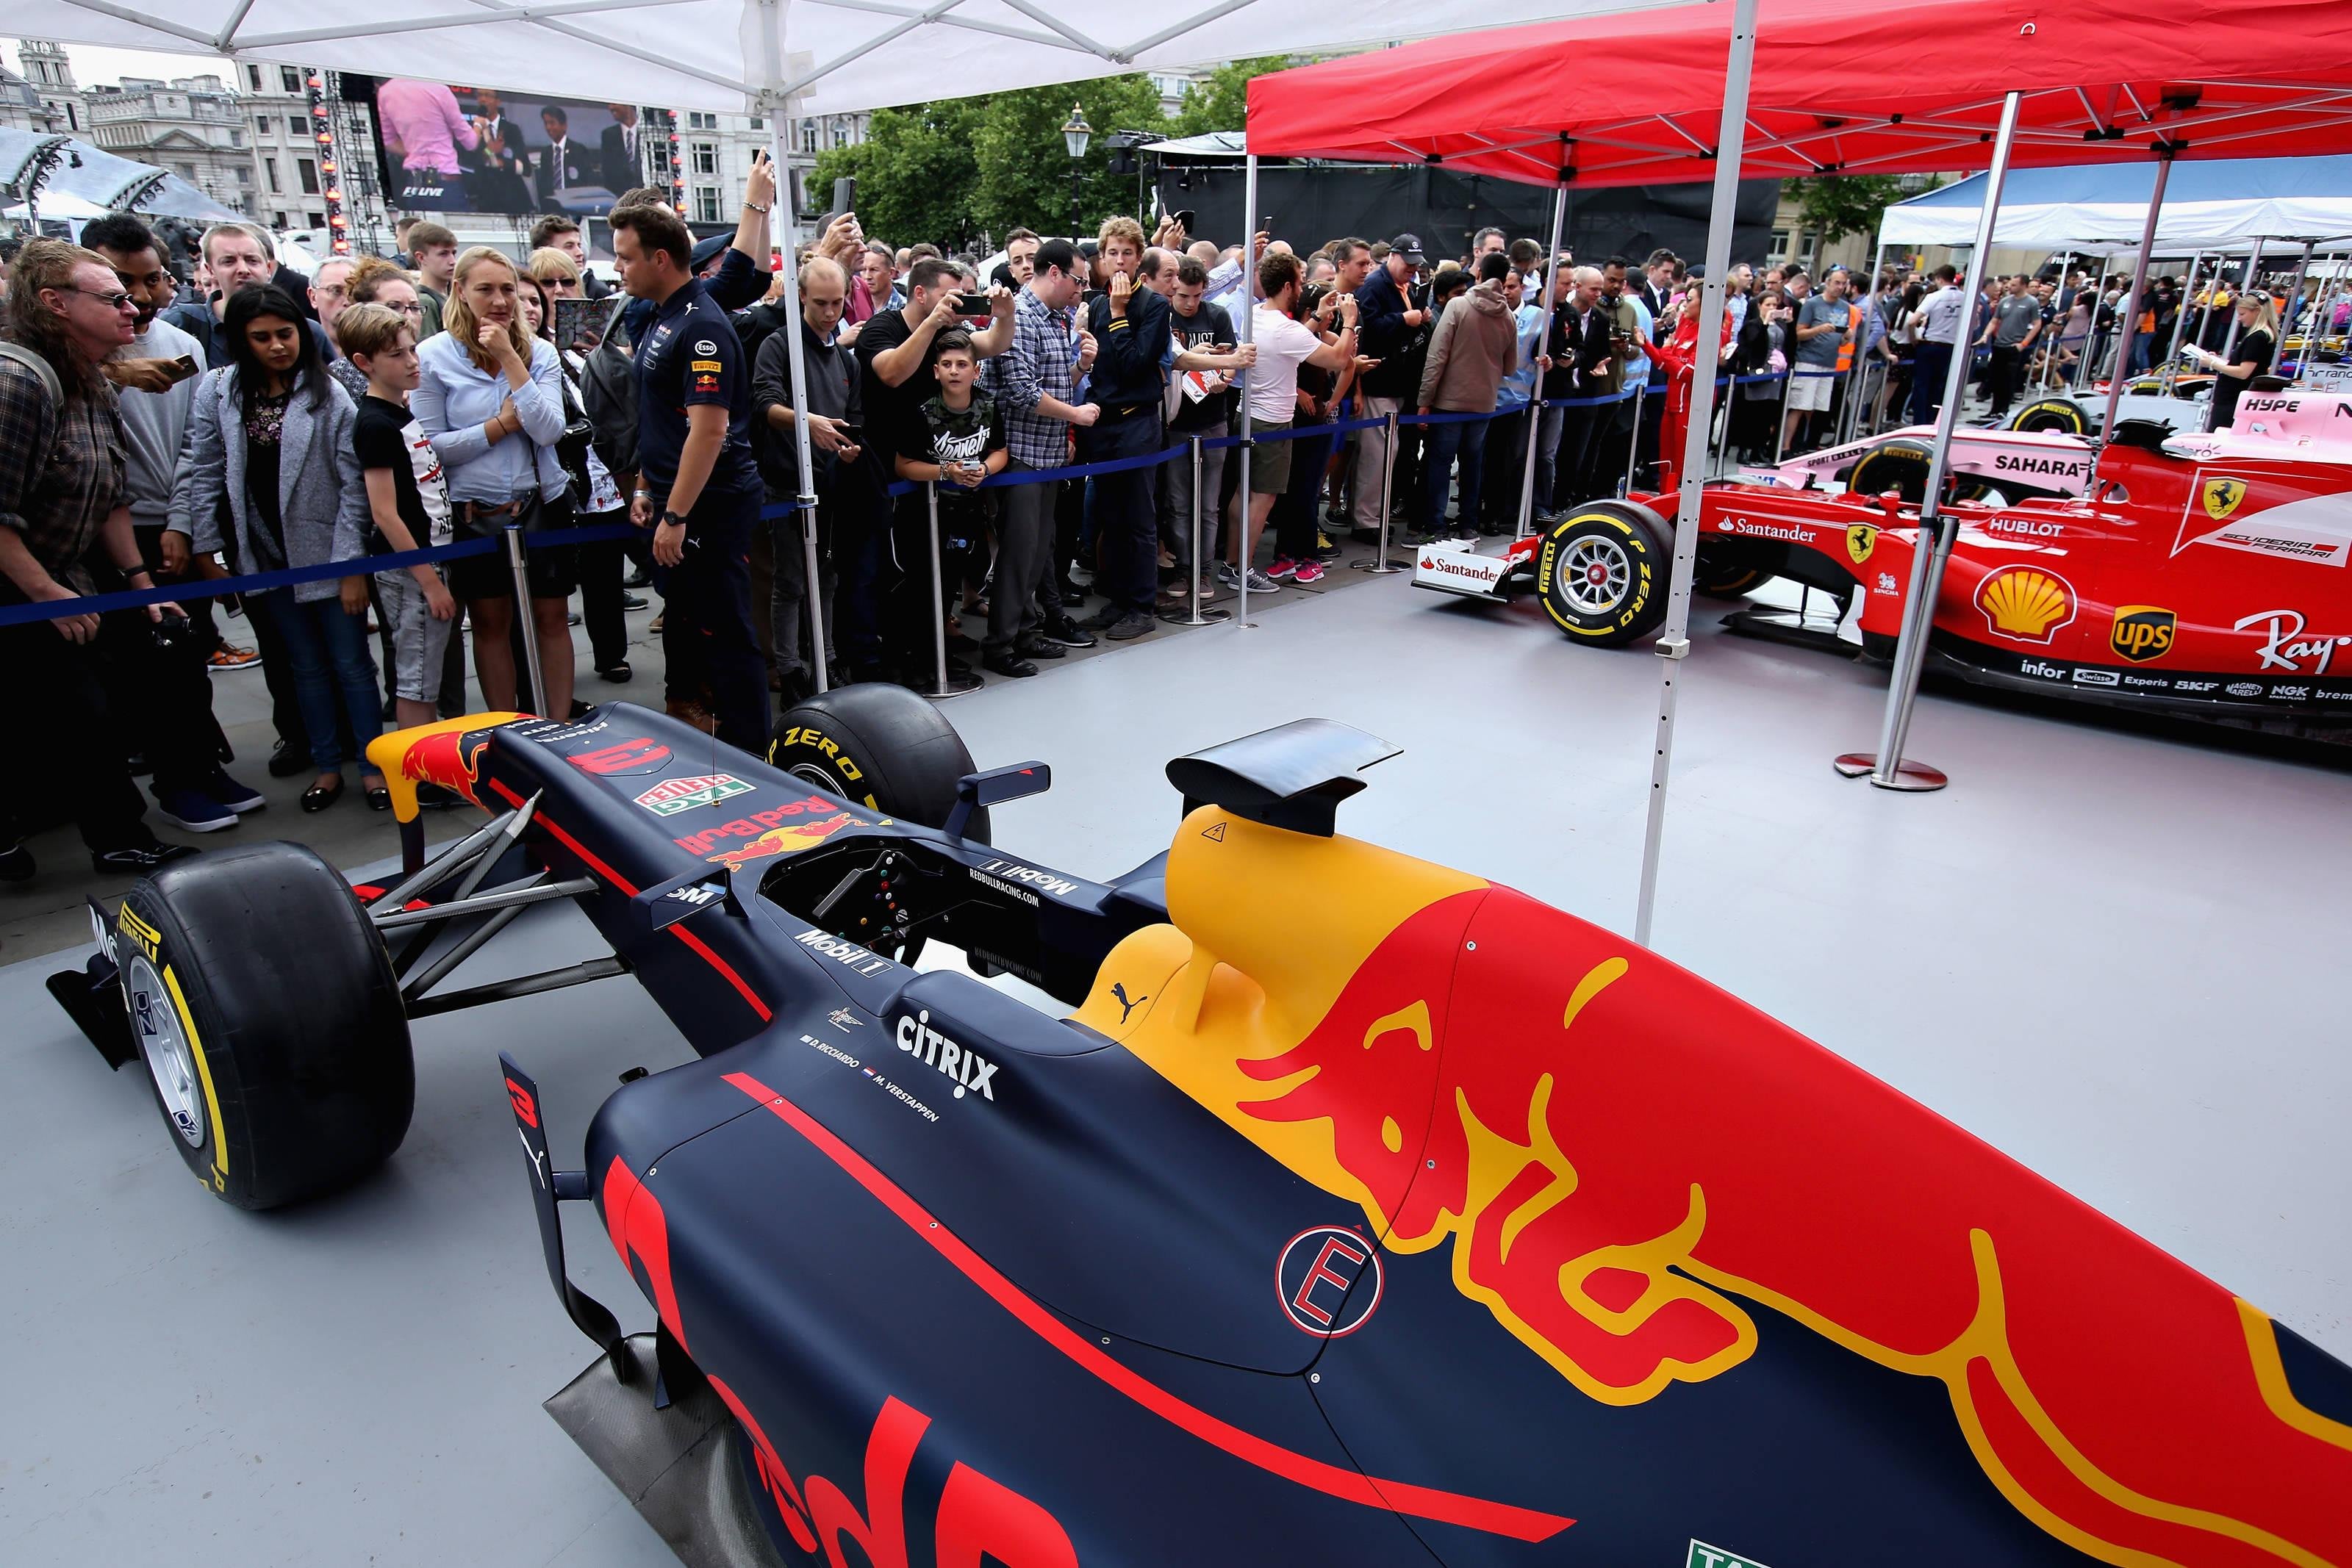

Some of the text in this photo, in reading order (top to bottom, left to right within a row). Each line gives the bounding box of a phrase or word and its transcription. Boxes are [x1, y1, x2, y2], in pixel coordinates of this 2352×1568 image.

[417, 187, 444, 197] LIVE
[2245, 399, 2301, 412] HYPE
[1807, 456, 1829, 467] SPORT
[1995, 455, 2079, 477] SAHARA
[1736, 518, 1816, 542] Santander
[1990, 518, 2064, 537] HUBLOT
[2223, 533, 2313, 549] SCUDERIA
[2252, 543, 2332, 558] FERRARI
[1436, 558, 1498, 582] Santander
[1539, 541, 1556, 594] PIRELLI
[1620, 540, 1652, 627] P ZERO
[1873, 588, 1899, 597] SINGHA
[2115, 622, 2171, 655] ups
[2021, 659, 2066, 679] infor
[2082, 672, 2111, 683] Swisse
[2124, 676, 2168, 687] Experis
[2174, 680, 2219, 691] SKF
[2271, 686, 2310, 697] NGK
[567, 738, 670, 774] 3
[784, 726, 863, 781] ZERO
[641, 777, 728, 804] HEUER
[658, 786, 744, 811] TAG
[969, 868, 1039, 907] REDBULLRACING.COM
[1001, 867, 1078, 896] Mobil
[119, 900, 161, 964] PIRELLI
[794, 928, 870, 965] Mobil
[505, 1077, 537, 1129] 3
[884, 1082, 940, 1123] VERSTAPPEN
[1292, 1236, 1366, 1326] E
